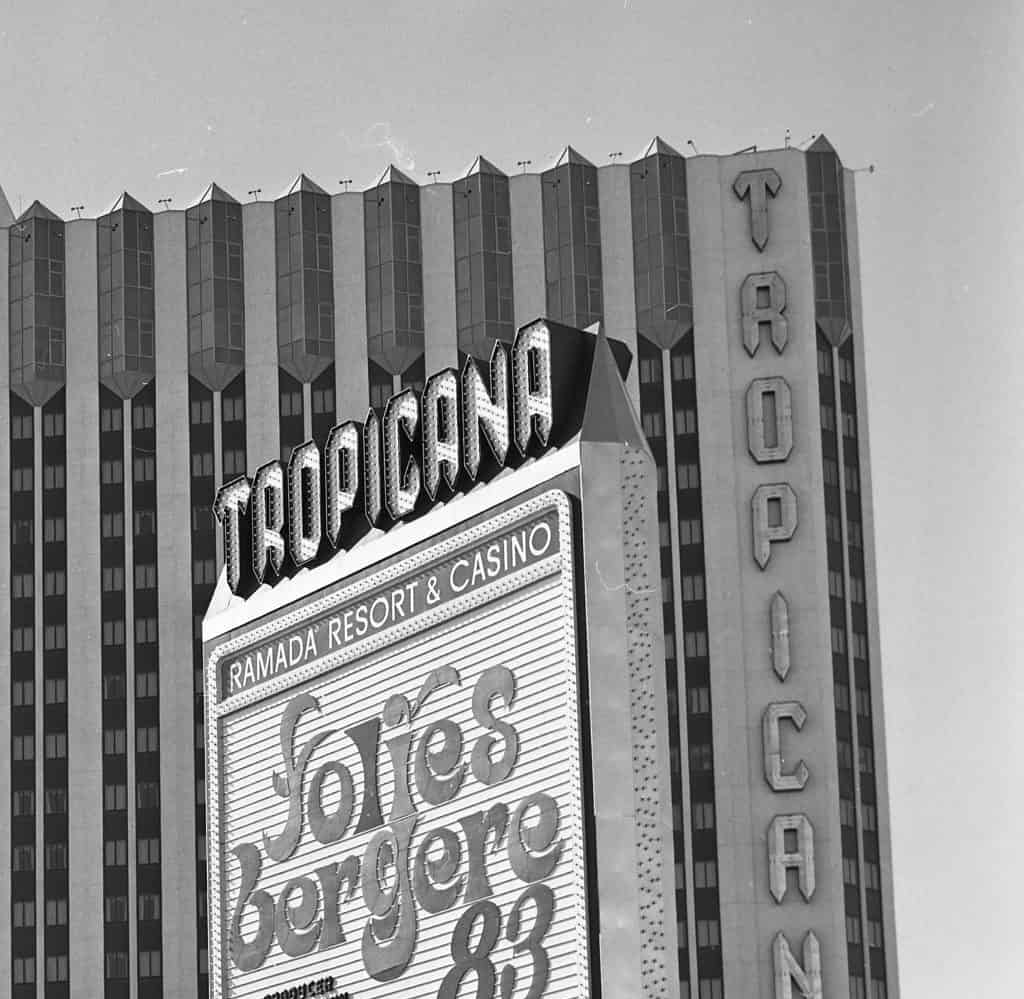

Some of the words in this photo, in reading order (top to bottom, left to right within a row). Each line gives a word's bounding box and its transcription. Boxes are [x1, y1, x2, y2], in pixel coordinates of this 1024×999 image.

[213, 318, 553, 594] TROPICANA
[230, 626, 319, 692] RAMADA
[328, 582, 417, 649] RESORT
[425, 575, 442, 605] &
[449, 523, 552, 588] CASINO
